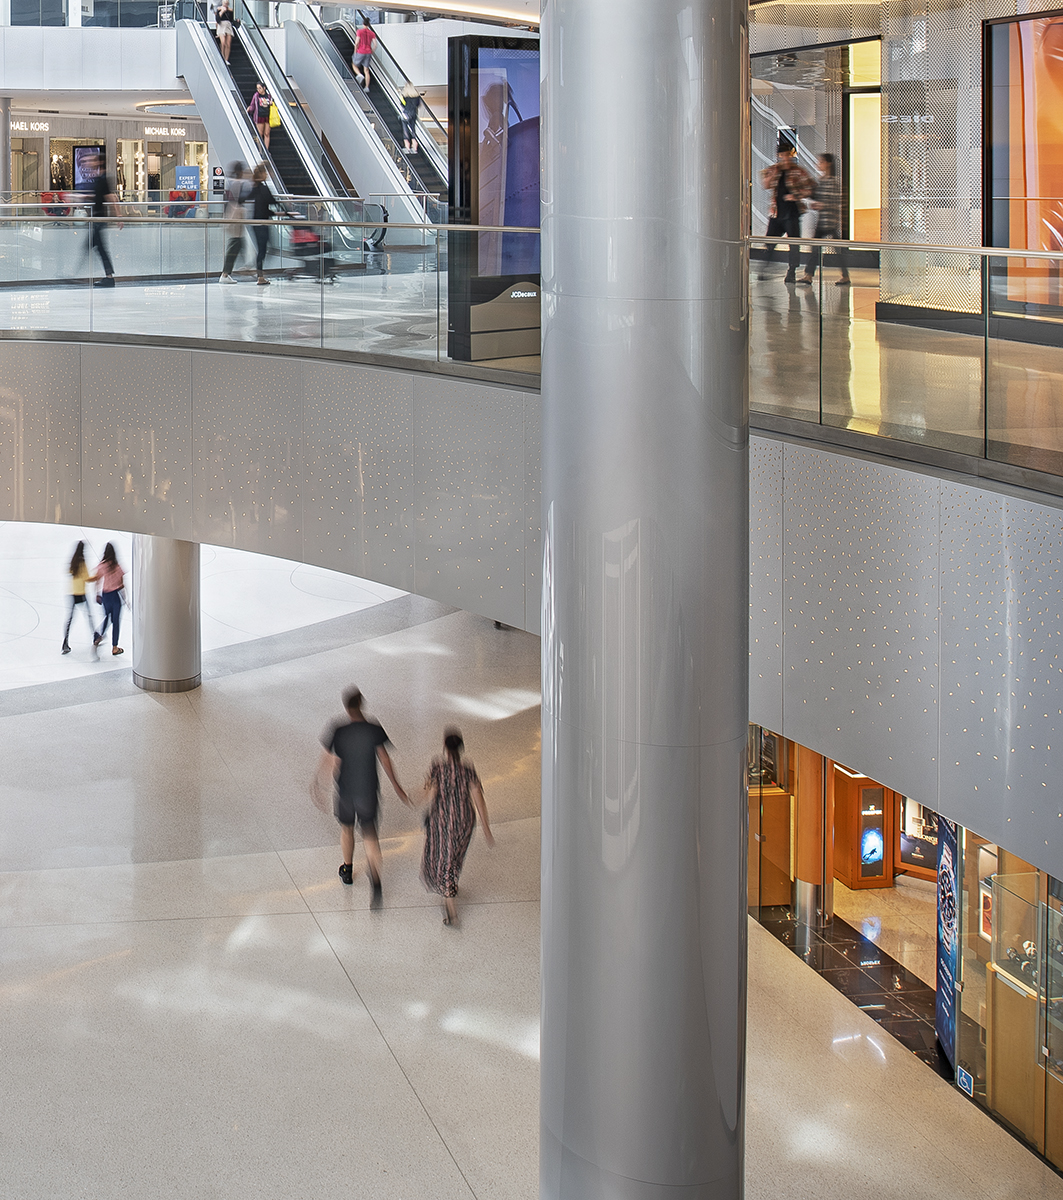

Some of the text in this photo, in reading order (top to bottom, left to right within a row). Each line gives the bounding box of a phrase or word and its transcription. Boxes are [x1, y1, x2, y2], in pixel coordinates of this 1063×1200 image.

[30, 121, 50, 132] KORS
[144, 126, 186, 137] MICHAEL KORS
[510, 291, 537, 299] JCDecaux
